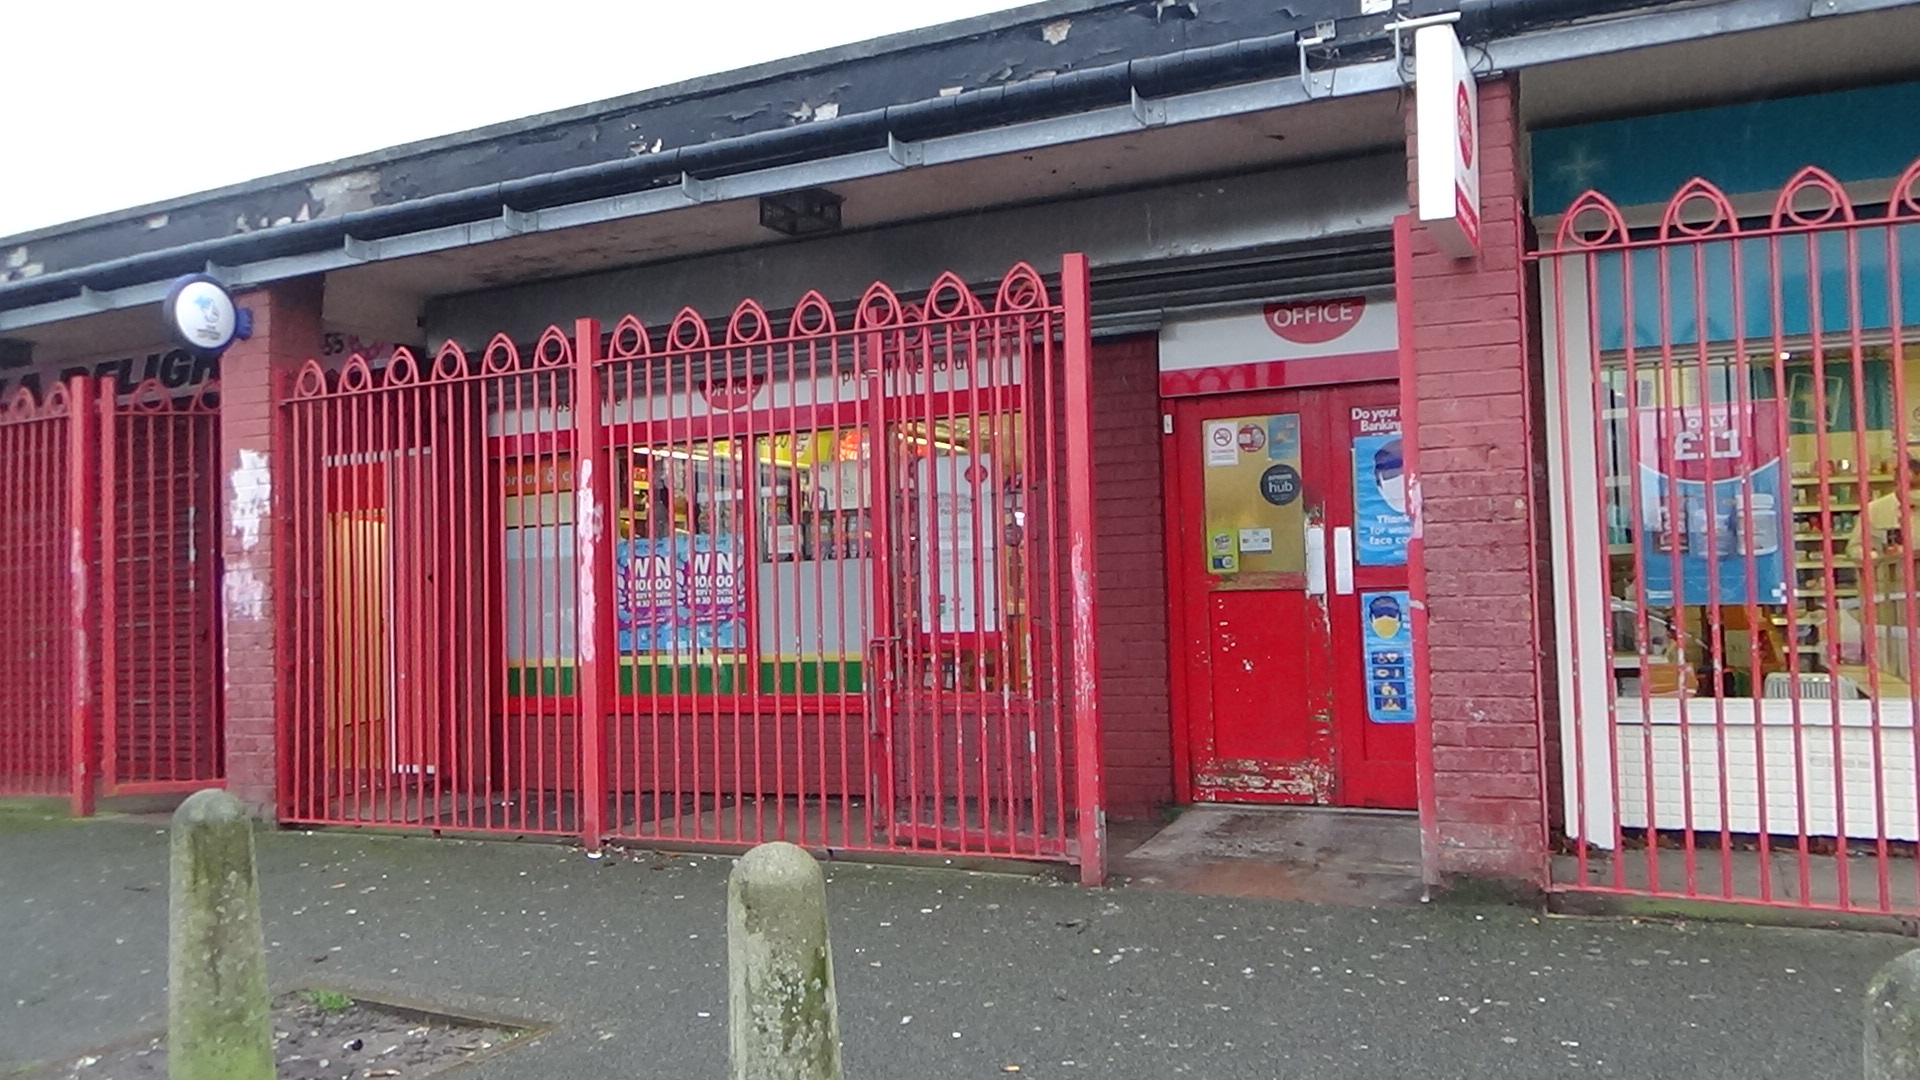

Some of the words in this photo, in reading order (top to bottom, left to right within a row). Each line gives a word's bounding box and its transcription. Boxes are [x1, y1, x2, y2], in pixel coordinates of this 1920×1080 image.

[1273, 303, 1353, 328] OFFICE
[1351, 407, 1370, 420] Do
[1371, 408, 1398, 422] your
[1687, 414, 1727, 429] OLY
[1268, 480, 1294, 493] hub
[1369, 536, 1393, 546] face
[628, 555, 671, 579] WN
[687, 552, 734, 575] WN
